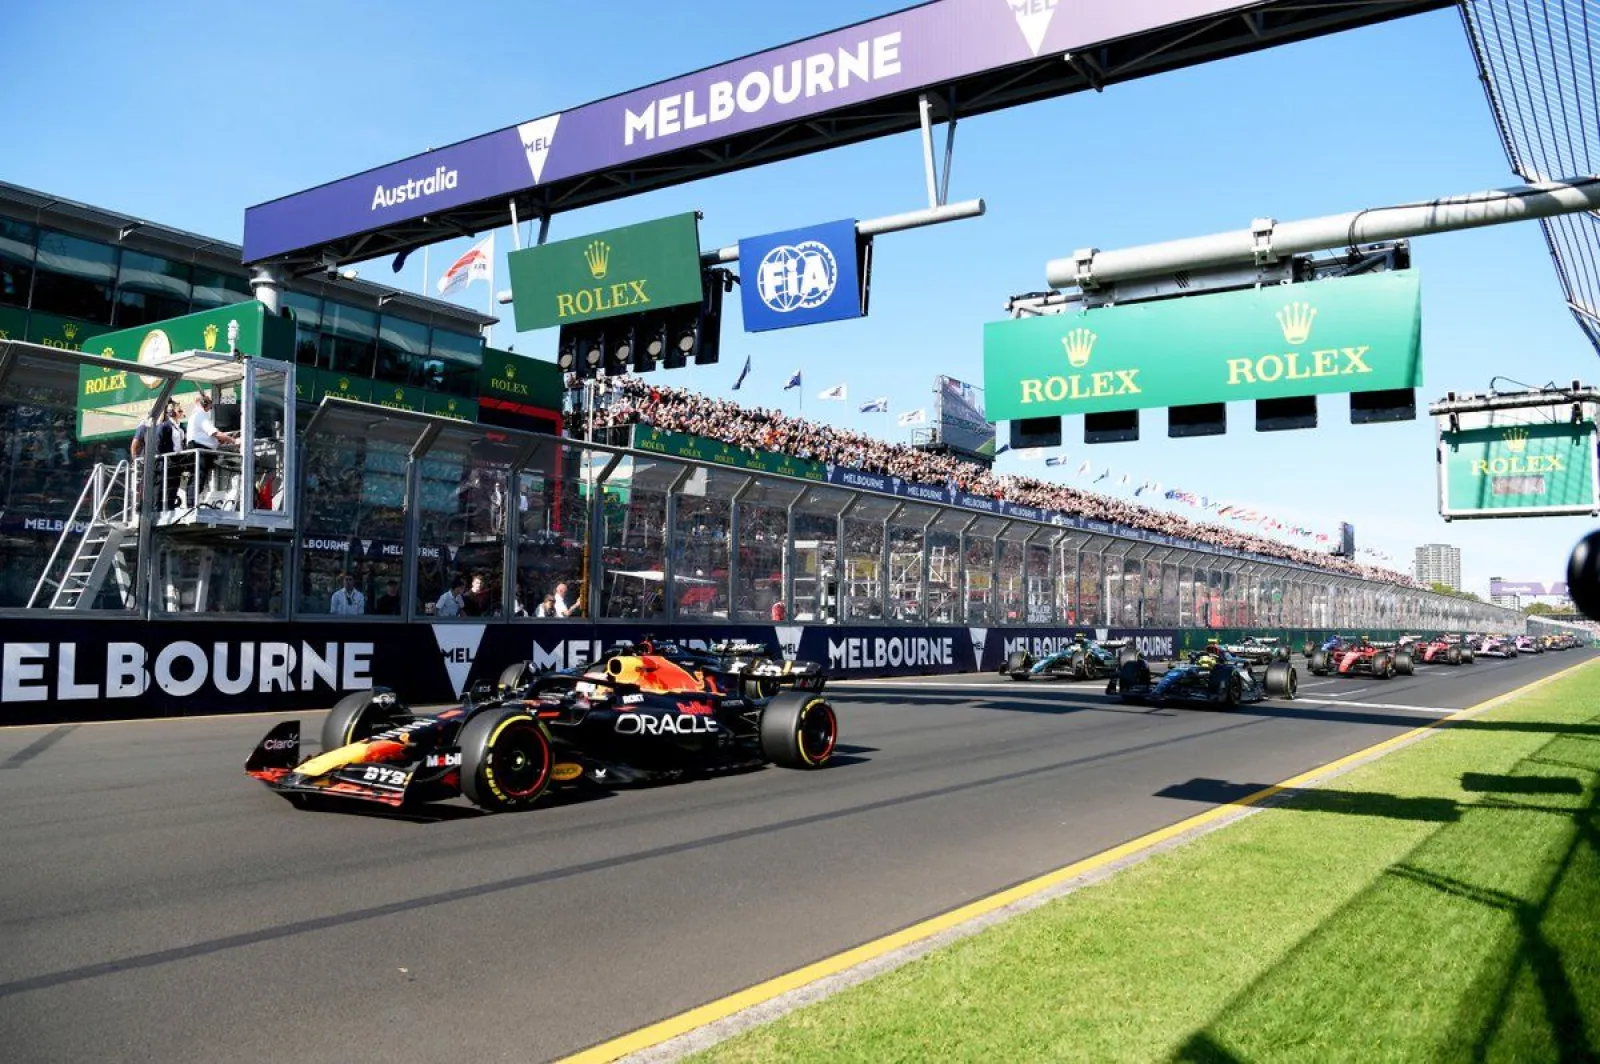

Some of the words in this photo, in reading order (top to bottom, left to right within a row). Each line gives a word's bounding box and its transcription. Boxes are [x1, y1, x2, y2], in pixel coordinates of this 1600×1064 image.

[624, 31, 902, 146] MELBOURNE
[524, 136, 552, 153] MEL
[372, 165, 458, 211] Australia
[558, 279, 650, 317] ROLEX
[43, 338, 80, 351] ROLE
[1226, 346, 1373, 385] ROLEX
[85, 371, 127, 395] ROLEX
[491, 378, 528, 394] ROLEX
[1020, 369, 1142, 404] ROLEX
[1471, 454, 1566, 476] ROLEX
[843, 473, 884, 489] MELBOURNE
[907, 486, 943, 501] MELBOURNE
[25, 517, 92, 533] MELBOU
[303, 539, 350, 551] LBOURNE
[383, 544, 439, 557] MELRNE
[441, 647, 475, 663] MEL
[780, 642, 799, 654] MEL
[828, 636, 953, 669] MELBOURNE
[2, 640, 374, 701] ELBOURNE
[614, 713, 719, 735] ORACLE
[264, 739, 294, 750] Claro
[426, 752, 462, 767] Mobil
